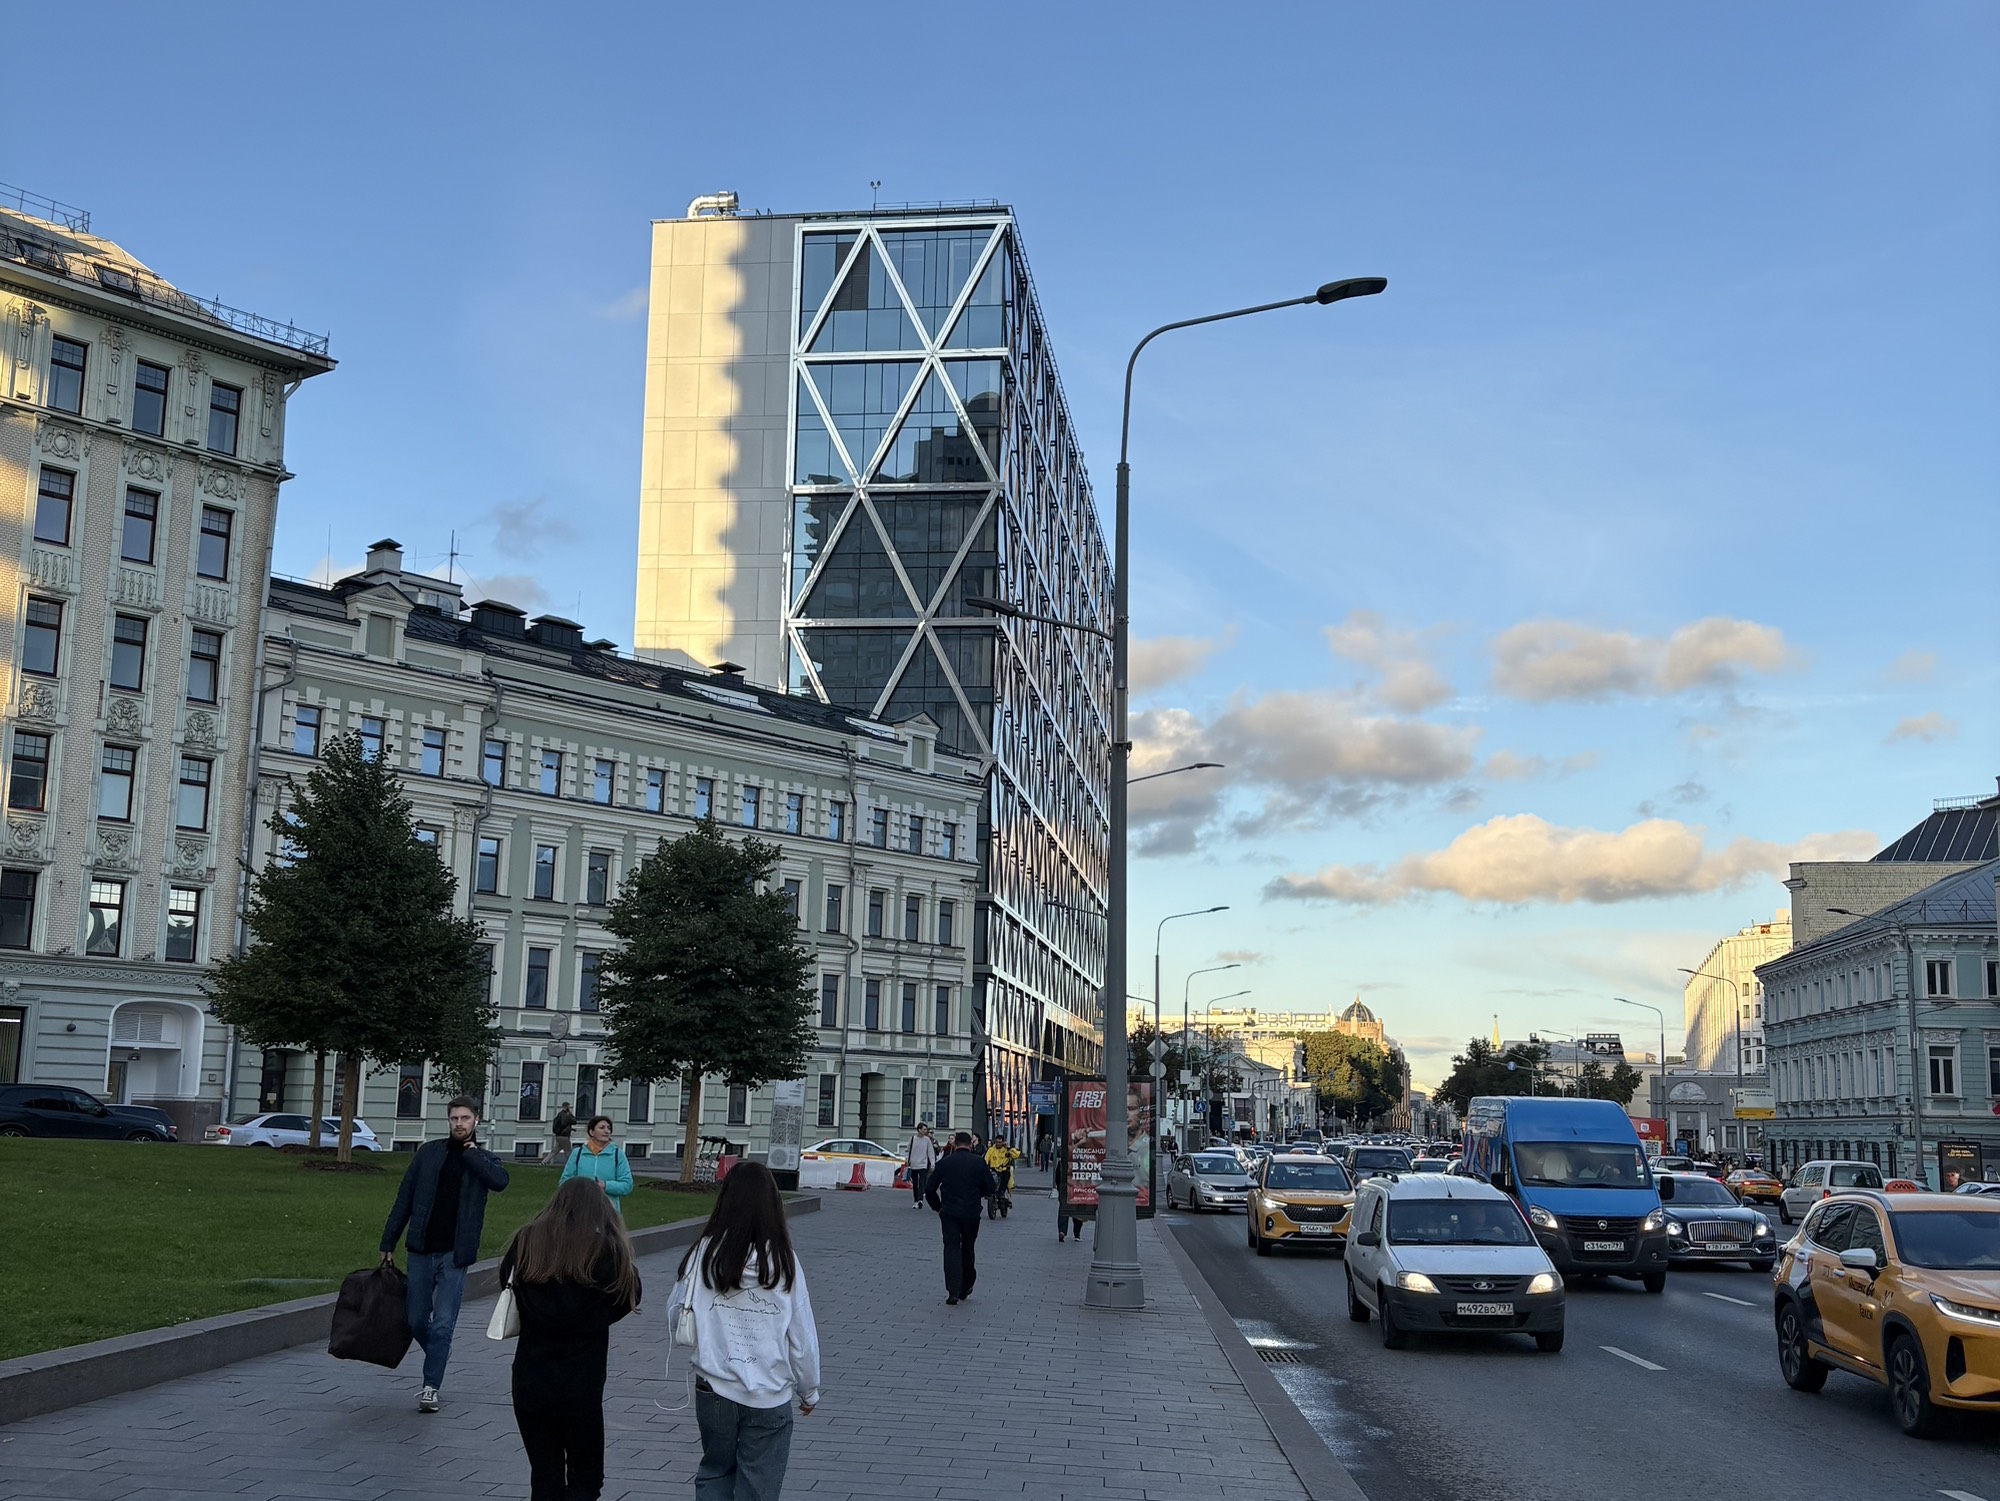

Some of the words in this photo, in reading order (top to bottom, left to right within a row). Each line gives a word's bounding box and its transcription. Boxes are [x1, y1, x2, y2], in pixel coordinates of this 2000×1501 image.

[1075, 1091, 1107, 1100] FIRST
[1072, 1162, 1079, 1170] В
[1080, 1162, 1102, 1171] КОМ
